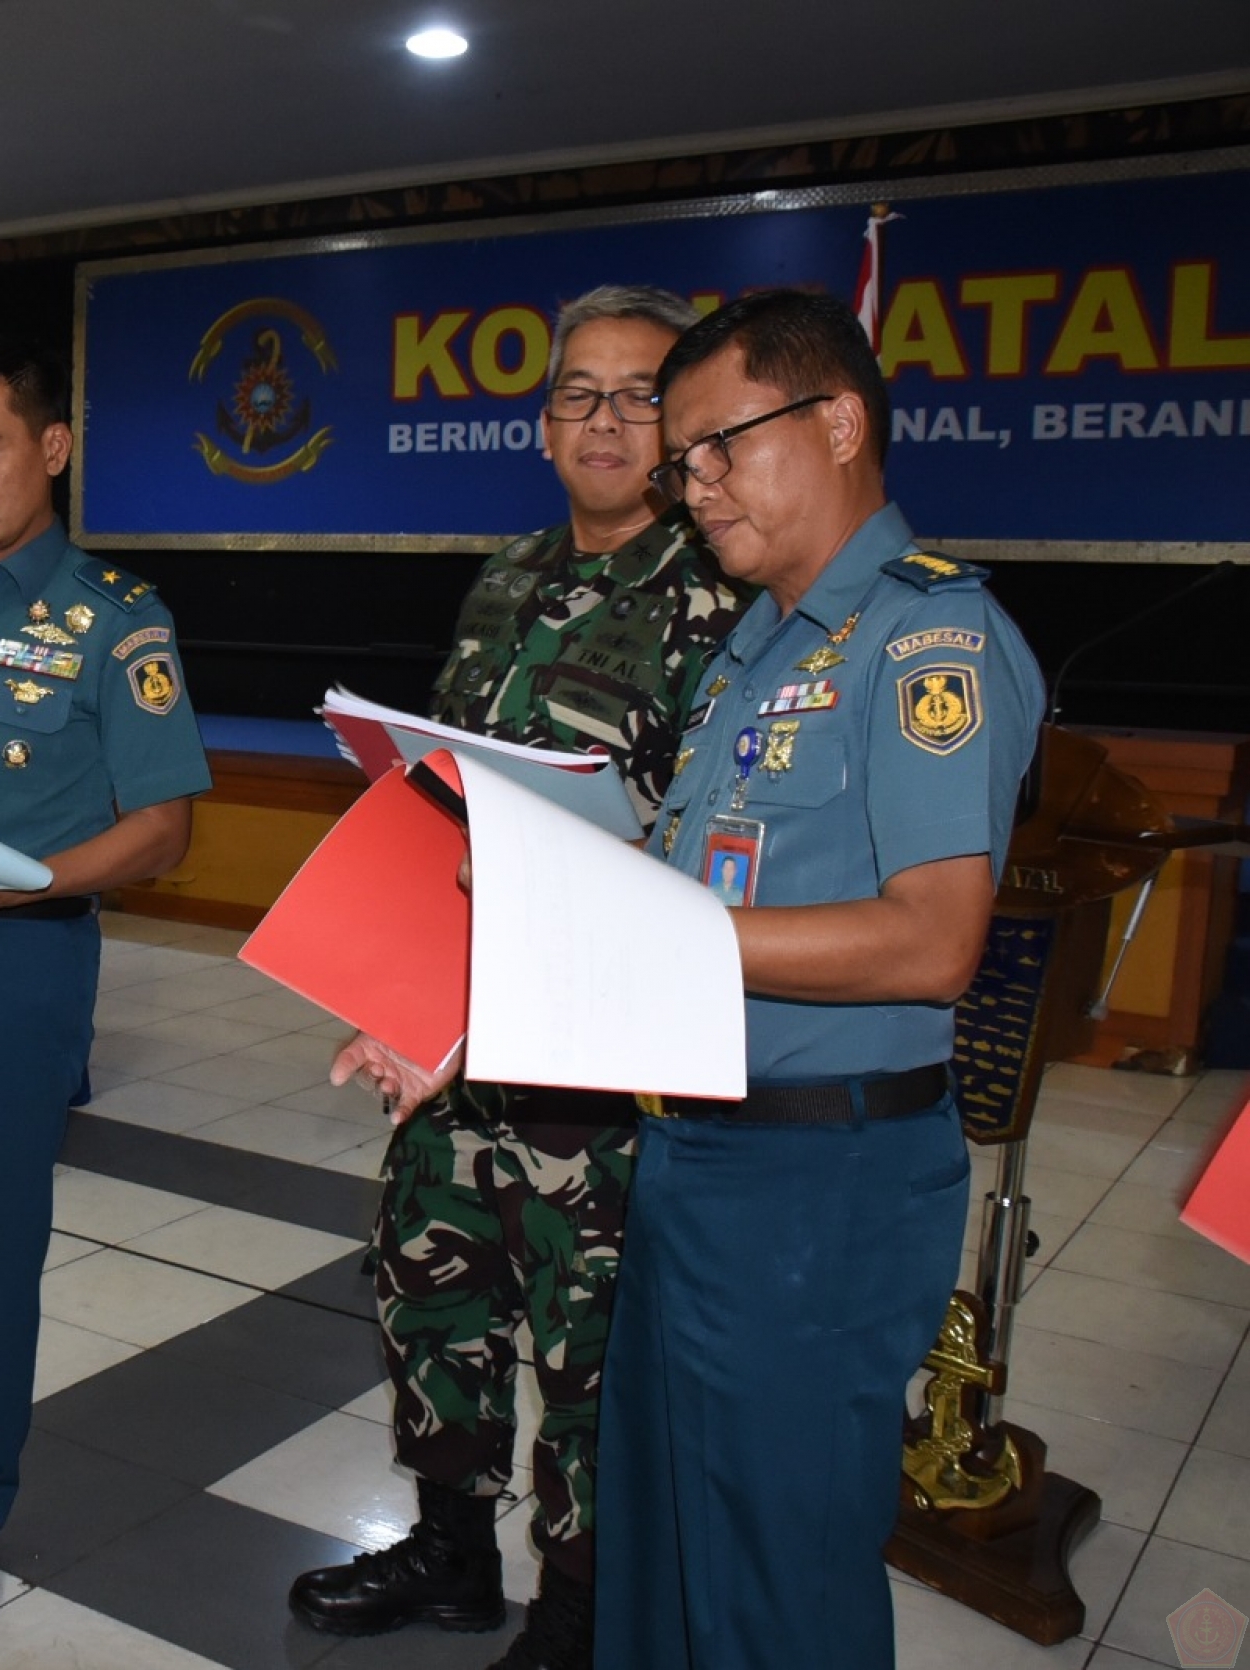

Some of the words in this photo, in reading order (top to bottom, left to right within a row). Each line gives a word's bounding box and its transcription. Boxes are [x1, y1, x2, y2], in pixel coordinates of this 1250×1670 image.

[896, 632, 973, 654] MABESAL
[578, 649, 610, 668] TNI
[612, 660, 638, 679] AL
